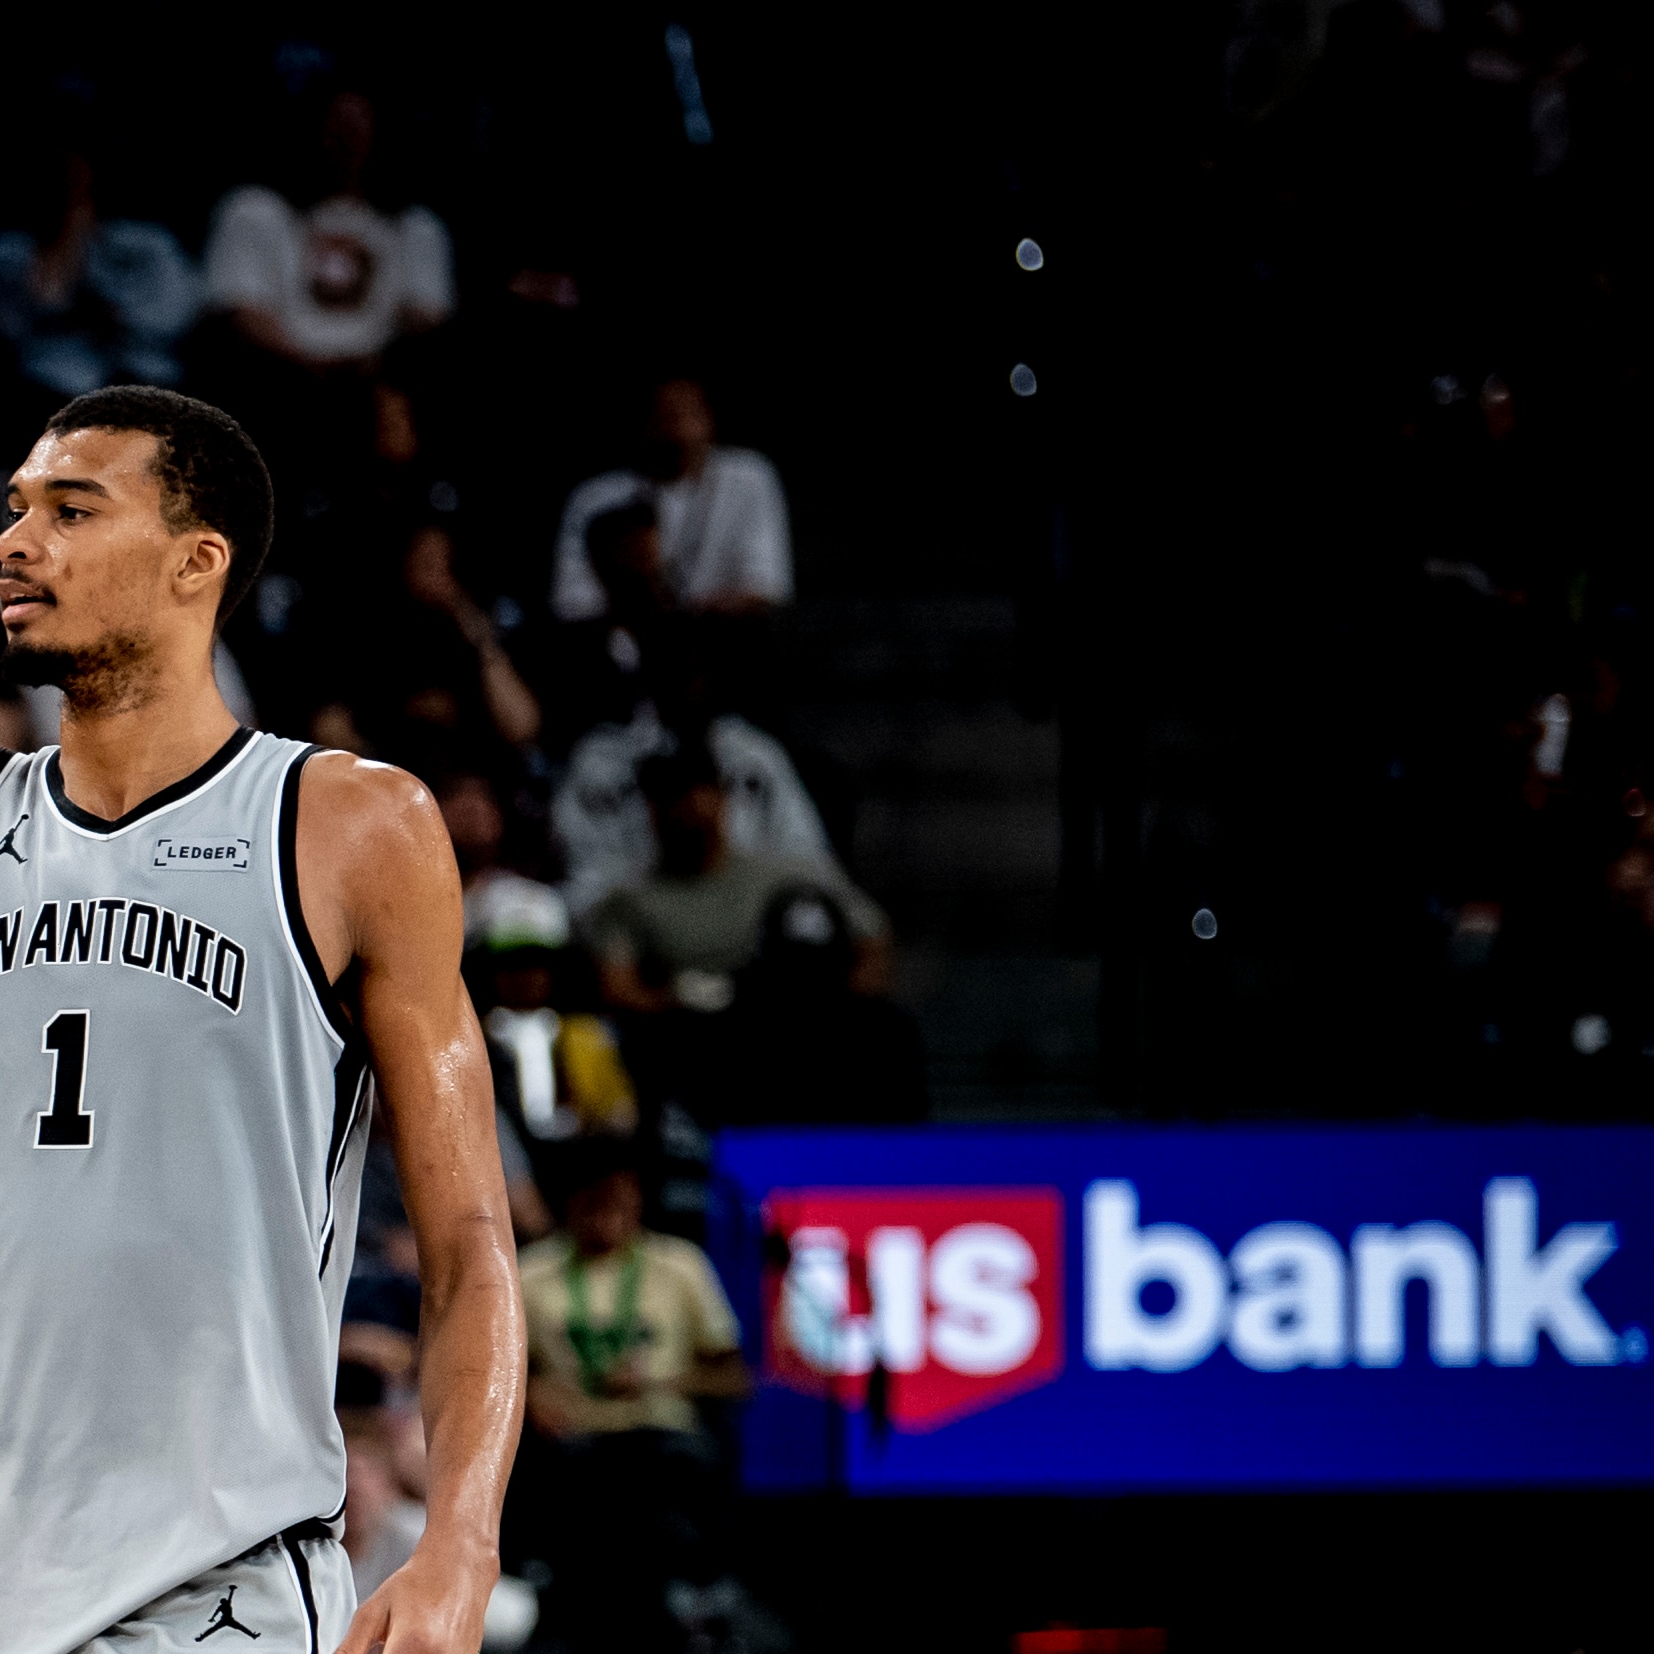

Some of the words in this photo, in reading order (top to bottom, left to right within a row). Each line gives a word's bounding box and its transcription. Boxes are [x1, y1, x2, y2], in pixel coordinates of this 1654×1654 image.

[166, 845, 237, 860] LEDGER
[22, 897, 248, 1016] ANTONIO
[33, 1008, 95, 1150] 1
[785, 1221, 1042, 1377] us
